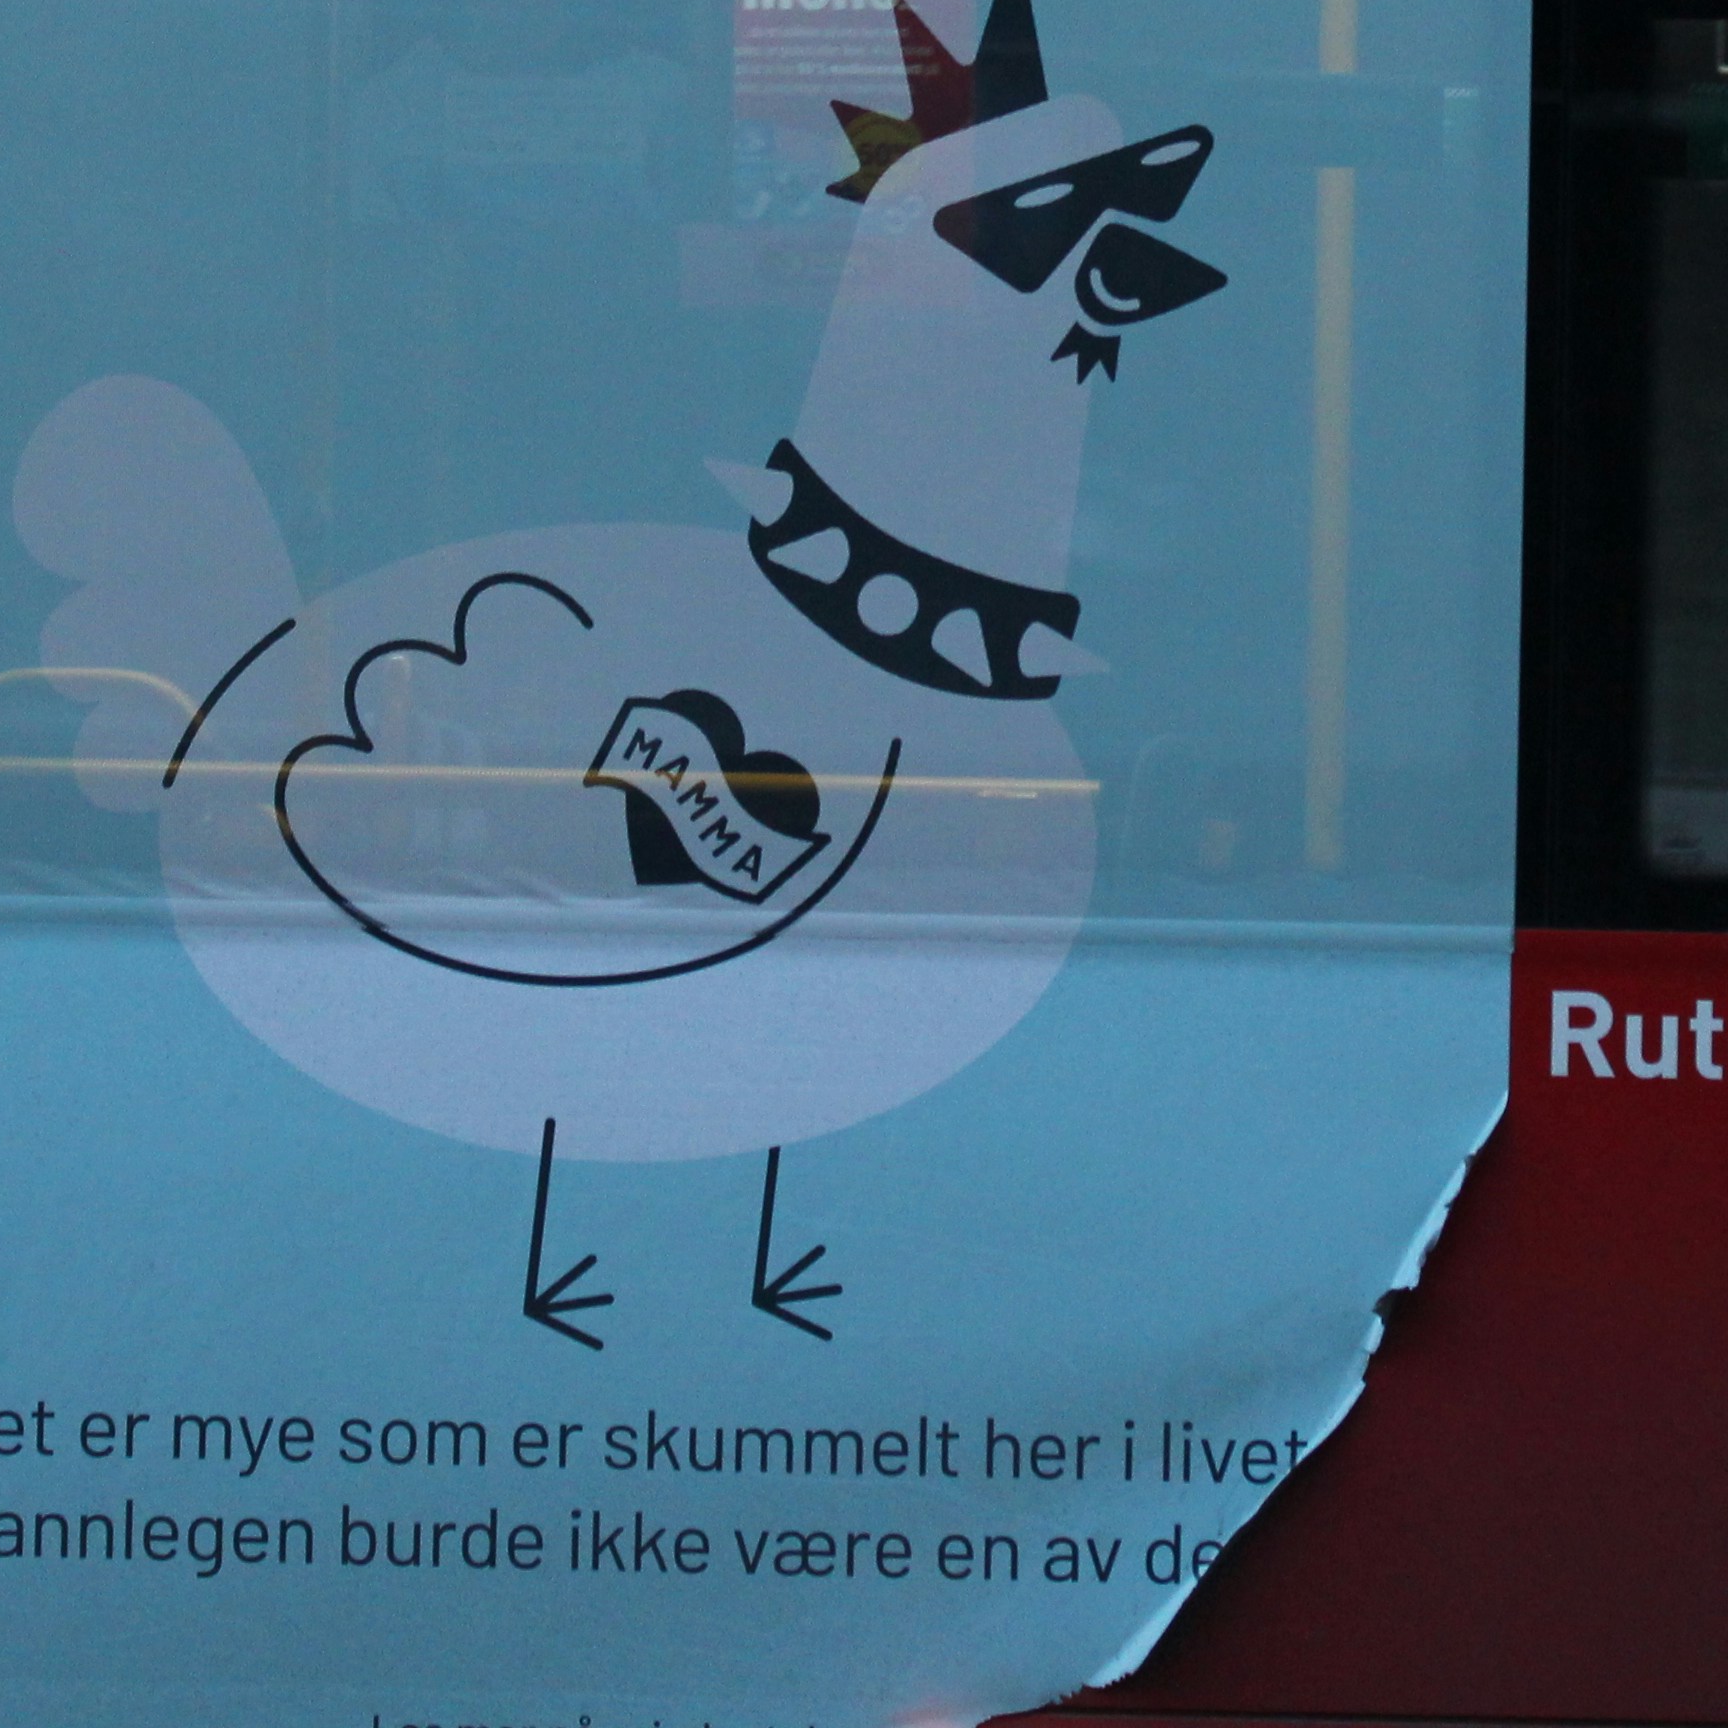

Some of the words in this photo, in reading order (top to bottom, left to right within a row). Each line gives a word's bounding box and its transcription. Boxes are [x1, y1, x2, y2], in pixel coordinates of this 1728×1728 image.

[623, 727, 763, 882] MAMMA
[79, 1410, 150, 1459] er
[172, 1412, 317, 1478] mye
[338, 1416, 487, 1468] som
[512, 1421, 584, 1470] er
[603, 1409, 960, 1479] skummelt
[985, 1417, 1101, 1480] her
[1124, 1419, 1135, 1482] i
[340, 1504, 545, 1570] burde
[570, 1508, 710, 1575] ikke
[733, 1529, 912, 1578] være
[936, 1532, 1020, 1581] en
[1041, 1537, 1122, 1584] av
